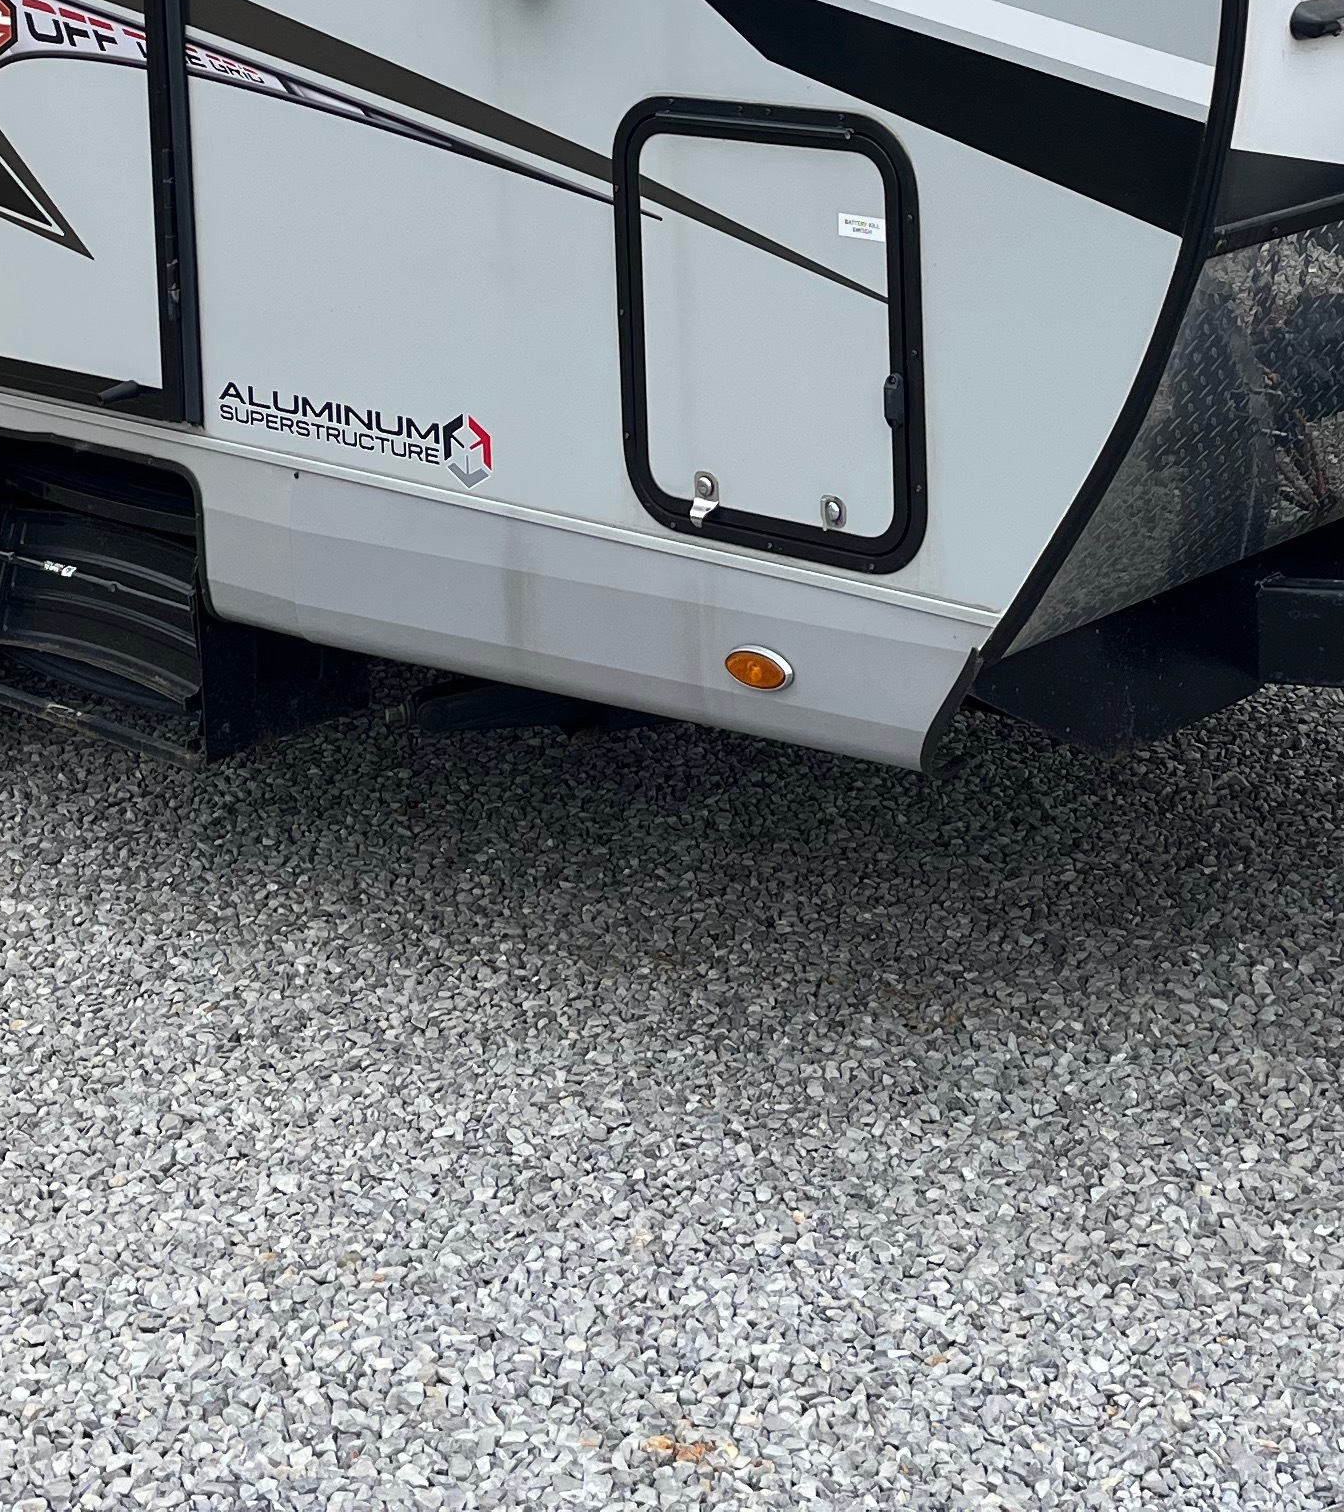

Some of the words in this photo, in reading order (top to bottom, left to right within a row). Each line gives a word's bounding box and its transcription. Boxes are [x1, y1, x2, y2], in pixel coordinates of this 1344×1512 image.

[206, 53, 266, 85] GRID
[218, 381, 441, 445] ALUMINUM
[219, 404, 441, 466] SUPERSTRUCTURE
